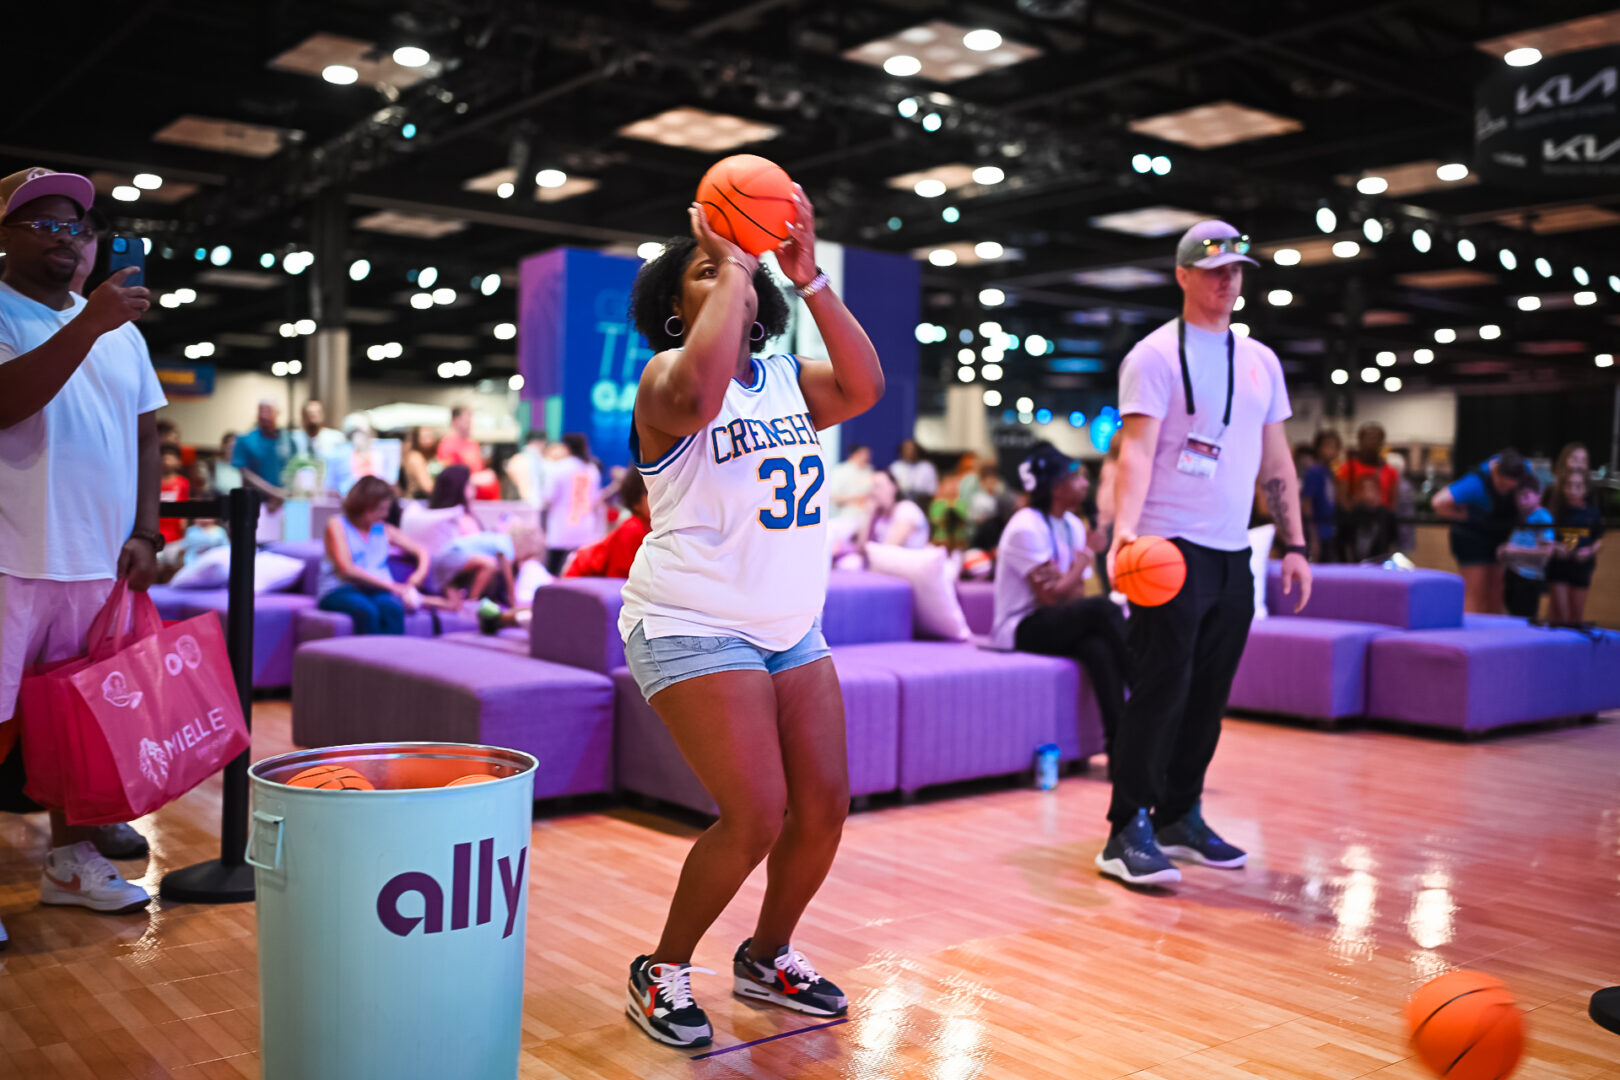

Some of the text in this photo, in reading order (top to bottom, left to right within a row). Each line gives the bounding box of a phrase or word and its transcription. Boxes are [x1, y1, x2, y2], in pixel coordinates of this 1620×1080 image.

[1516, 67, 1618, 114] KIA
[757, 454, 825, 531] 32
[163, 707, 226, 760] MIELLE
[376, 837, 528, 940] ally
